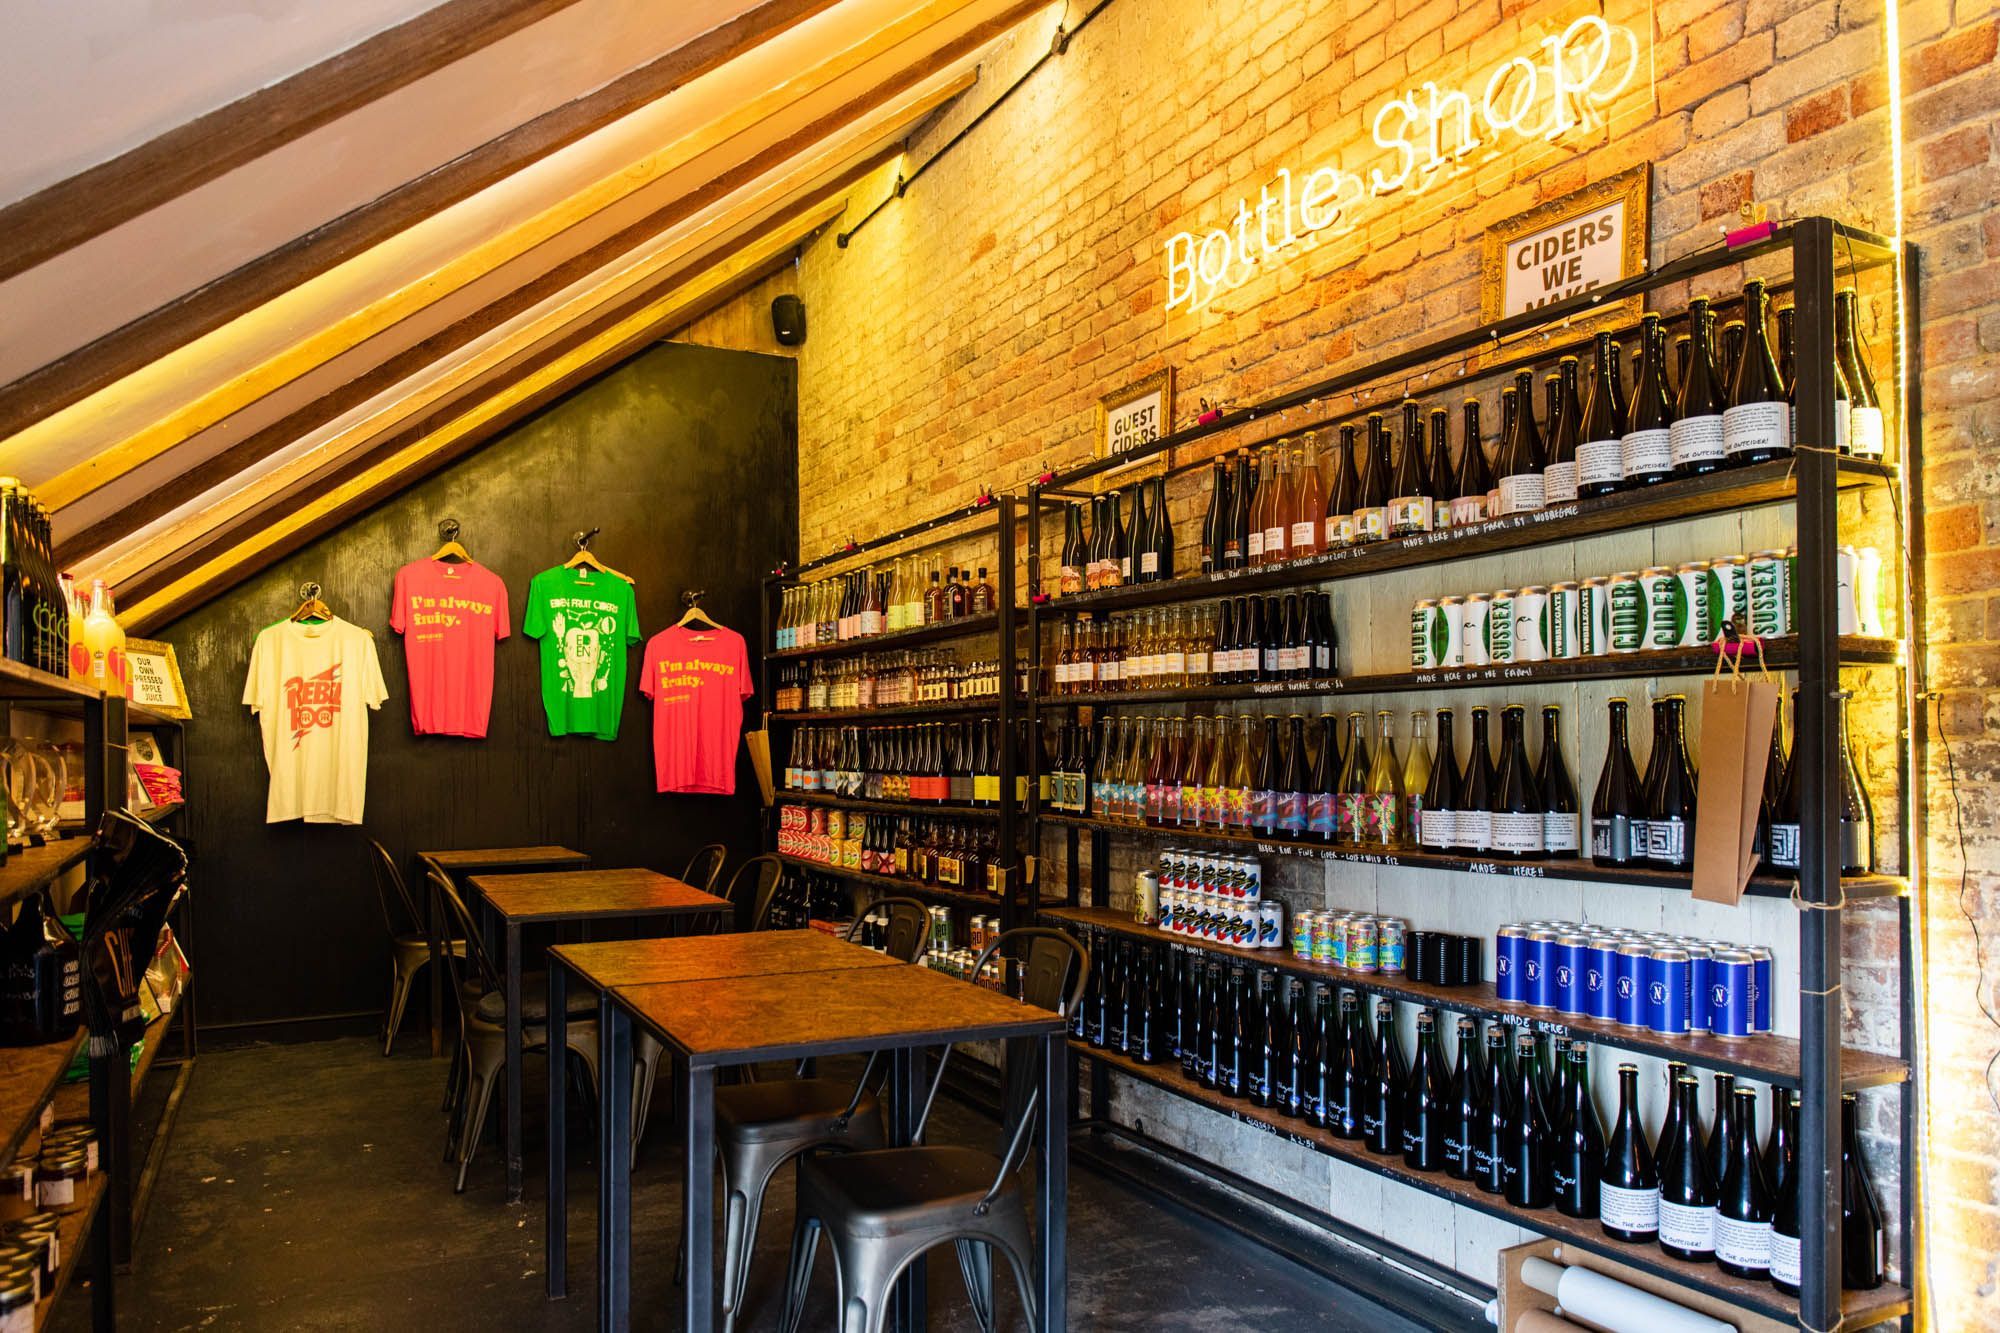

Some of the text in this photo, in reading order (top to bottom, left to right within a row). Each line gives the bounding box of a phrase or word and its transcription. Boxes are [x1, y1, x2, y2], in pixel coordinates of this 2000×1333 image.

[1165, 14, 1612, 312] Bottle Shop
[1516, 214, 1614, 271] CIDERS
[1542, 256, 1582, 291] WE
[1114, 405, 1156, 436] GUEST
[1112, 425, 1157, 455] CIDERS
[1733, 438, 1769, 449] OUTCIDER!
[1635, 462, 1669, 471] OUTCIDER!
[1402, 537, 1424, 549] MADE
[1428, 532, 1449, 544] HERE
[1454, 530, 1464, 539] ON
[411, 595, 493, 615] I'm always
[571, 598, 592, 609] FRUIT
[1751, 563, 1778, 636] SUSSEX
[1611, 583, 1639, 650] CIDER
[1652, 579, 1676, 646] CIDER
[1554, 594, 1563, 656] WOBBLEGATE
[1582, 590, 1591, 653] WOBBLEGATE
[1411, 609, 1428, 667] CIDER
[1492, 600, 1512, 661] SUSSEX
[137, 657, 151, 666] OUR
[658, 659, 735, 675] I'm always
[139, 666, 154, 675] OWN
[1416, 674, 1437, 683] MADE
[1466, 671, 1478, 680] ON
[134, 674, 164, 685] PRESSED
[661, 674, 705, 689] fruity.
[141, 684, 161, 693] APPLE
[145, 693, 164, 702] JUICE
[1298, 847, 1314, 857] FINE
[1468, 862, 1545, 877] MADE HERE!!
[1500, 959, 1506, 972] N
[1528, 964, 1535, 977] N
[1560, 970, 1568, 984] N
[1588, 973, 1597, 987] N
[1621, 980, 1629, 994] N
[1653, 986, 1662, 1000] N
[1715, 988, 1724, 1003] N
[1502, 1013, 1569, 1037] MADE HERE!
[1668, 1236, 1702, 1248] OUTCIDER!
[1725, 1252, 1737, 1260] THE
